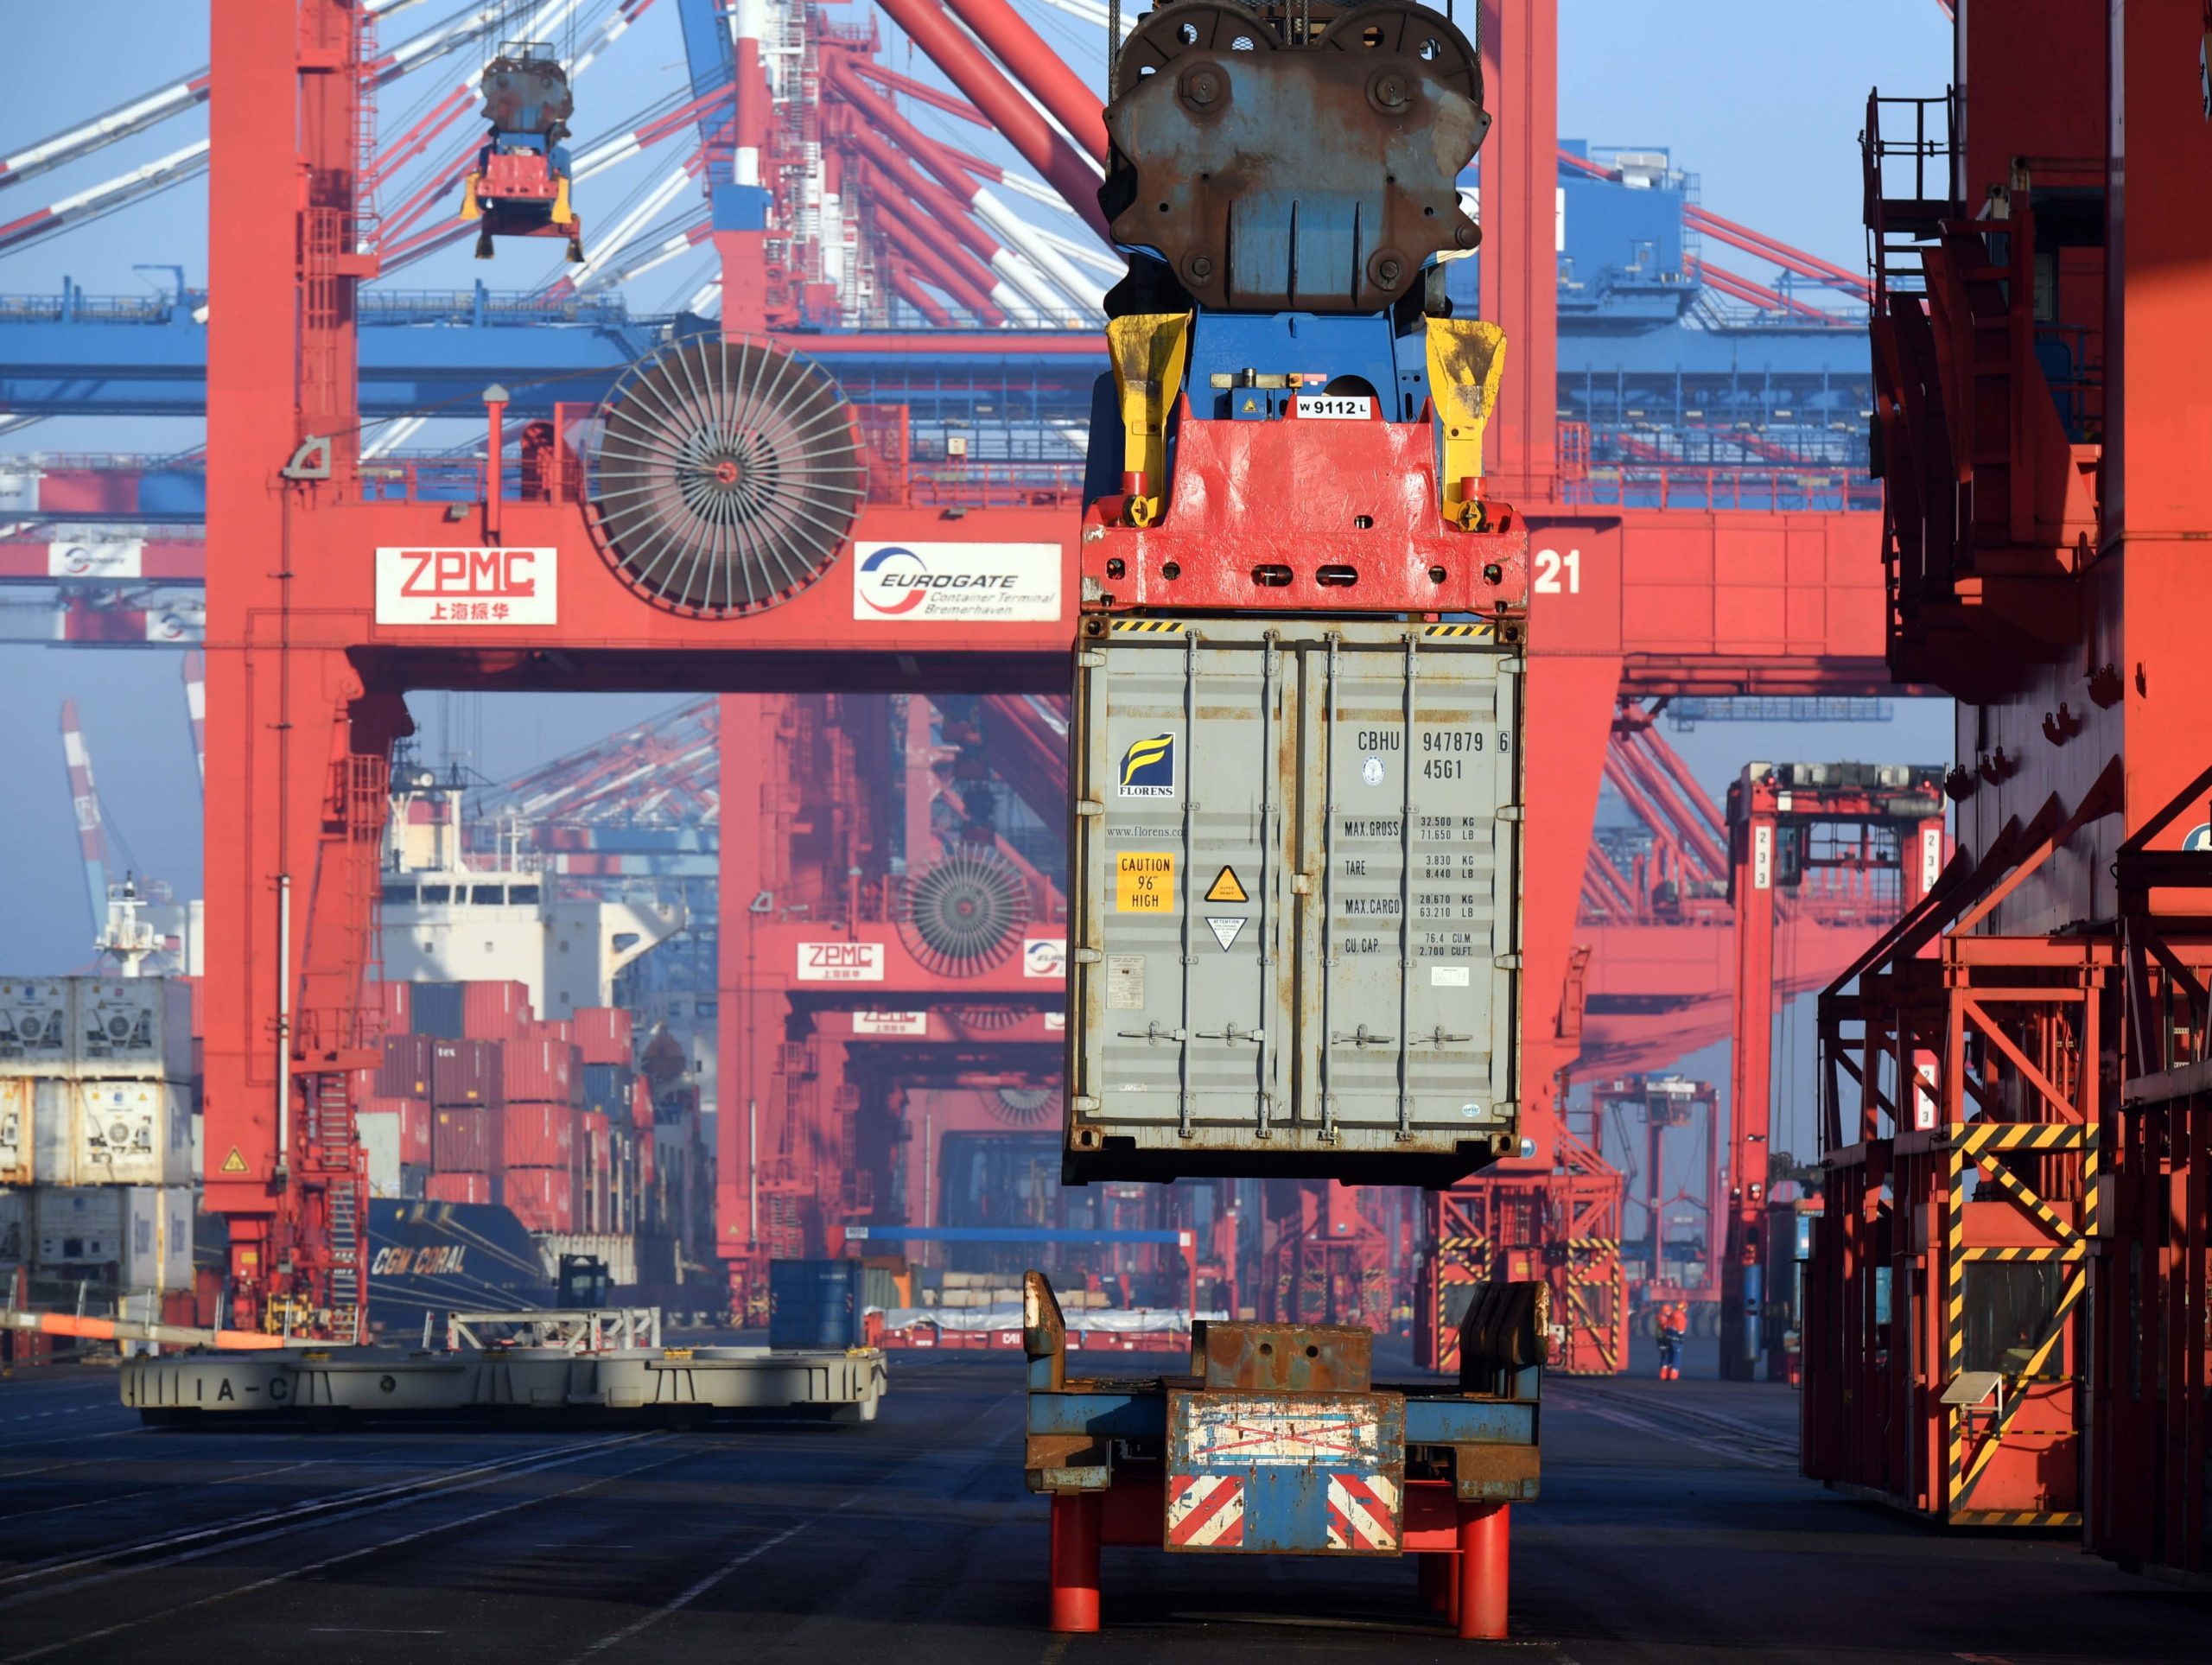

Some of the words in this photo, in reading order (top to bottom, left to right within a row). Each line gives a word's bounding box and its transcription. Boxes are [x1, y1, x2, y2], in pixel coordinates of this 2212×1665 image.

[1300, 403, 1310, 411] W
[1314, 401, 1356, 415] 9112
[1360, 404, 1366, 412] L
[401, 551, 535, 597] ZPMC
[1535, 549, 1580, 594] 21
[880, 574, 1018, 588] EUROGATE
[931, 592, 995, 602] Container
[999, 593, 1055, 603] Terminal
[925, 604, 1013, 614] Bremerhaven
[1358, 731, 1400, 751] CBHU
[1423, 732, 1484, 752] 947879
[1499, 733, 1509, 752] 6
[1424, 759, 1462, 779] 45G1
[1120, 786, 1173, 796] FLORENS
[1107, 825, 1187, 837] www.florens.co
[1344, 821, 1399, 837] MAX.GROSS
[1421, 817, 1452, 827] 32.500
[1462, 817, 1474, 827] KG
[1421, 829, 1452, 841] 71.650
[1462, 829, 1474, 840] LB
[1122, 858, 1170, 872] CAUTION
[1345, 861, 1366, 875] TARE
[1426, 855, 1451, 866] 3.830
[1462, 855, 1474, 866] KG
[1426, 868, 1451, 879] 8.440
[1462, 868, 1474, 879] LB
[1132, 894, 1159, 907] HIGH
[1345, 899, 1400, 914] MAX.CARGO
[1420, 894, 1451, 905] 28.670
[1461, 894, 1473, 905] KG
[1420, 907, 1451, 918] 63.210
[1461, 907, 1473, 918] LB
[1426, 933, 1444, 944] 76.4
[809, 945, 873, 967] ZPMC
[1419, 946, 1445, 956] 2.700
[413, 1245, 466, 1274] CORAL
[1002, 1333, 1020, 1344] CAI
